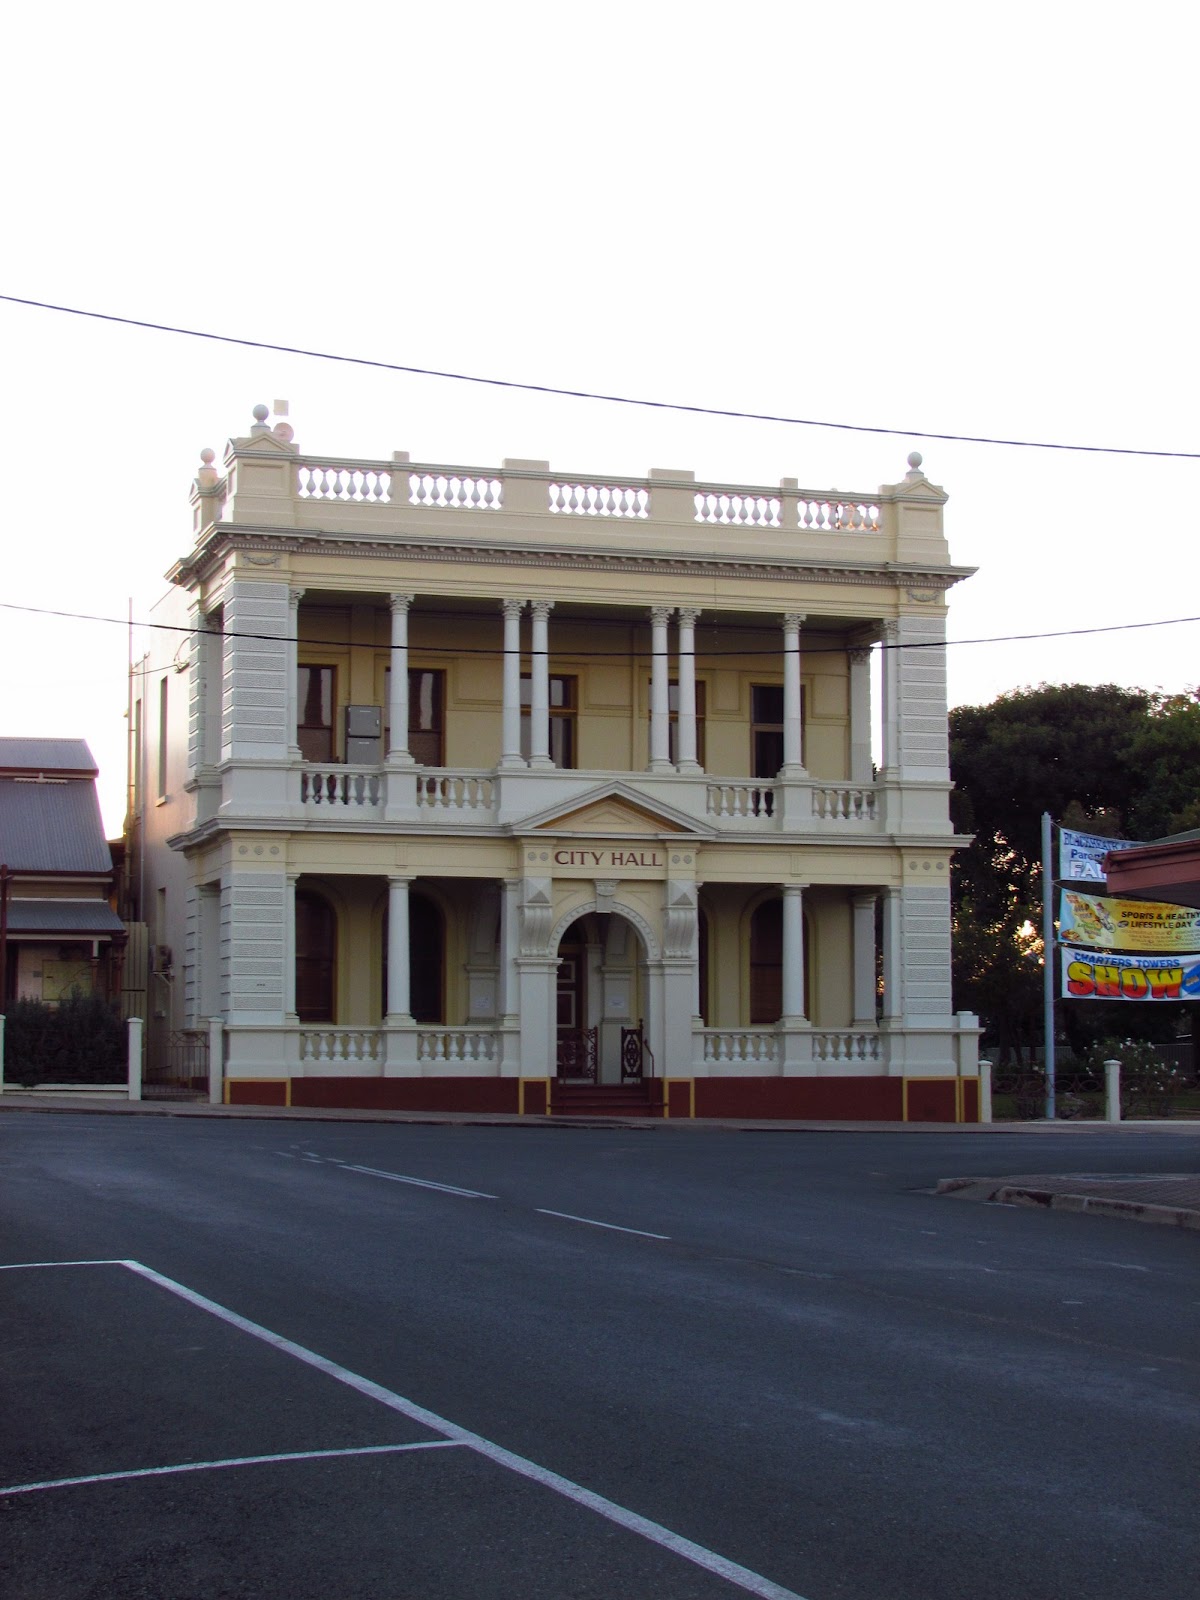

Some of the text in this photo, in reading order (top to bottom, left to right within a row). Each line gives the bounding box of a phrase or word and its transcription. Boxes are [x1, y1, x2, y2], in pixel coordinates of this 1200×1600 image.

[554, 850, 663, 867] CITY HALL
[1121, 911, 1154, 920] SPORTS
[1131, 920, 1192, 929] LIFESTYLE DAY
[1074, 952, 1180, 968] CHARTERS TOWERS
[1067, 961, 1184, 999] SHOW
